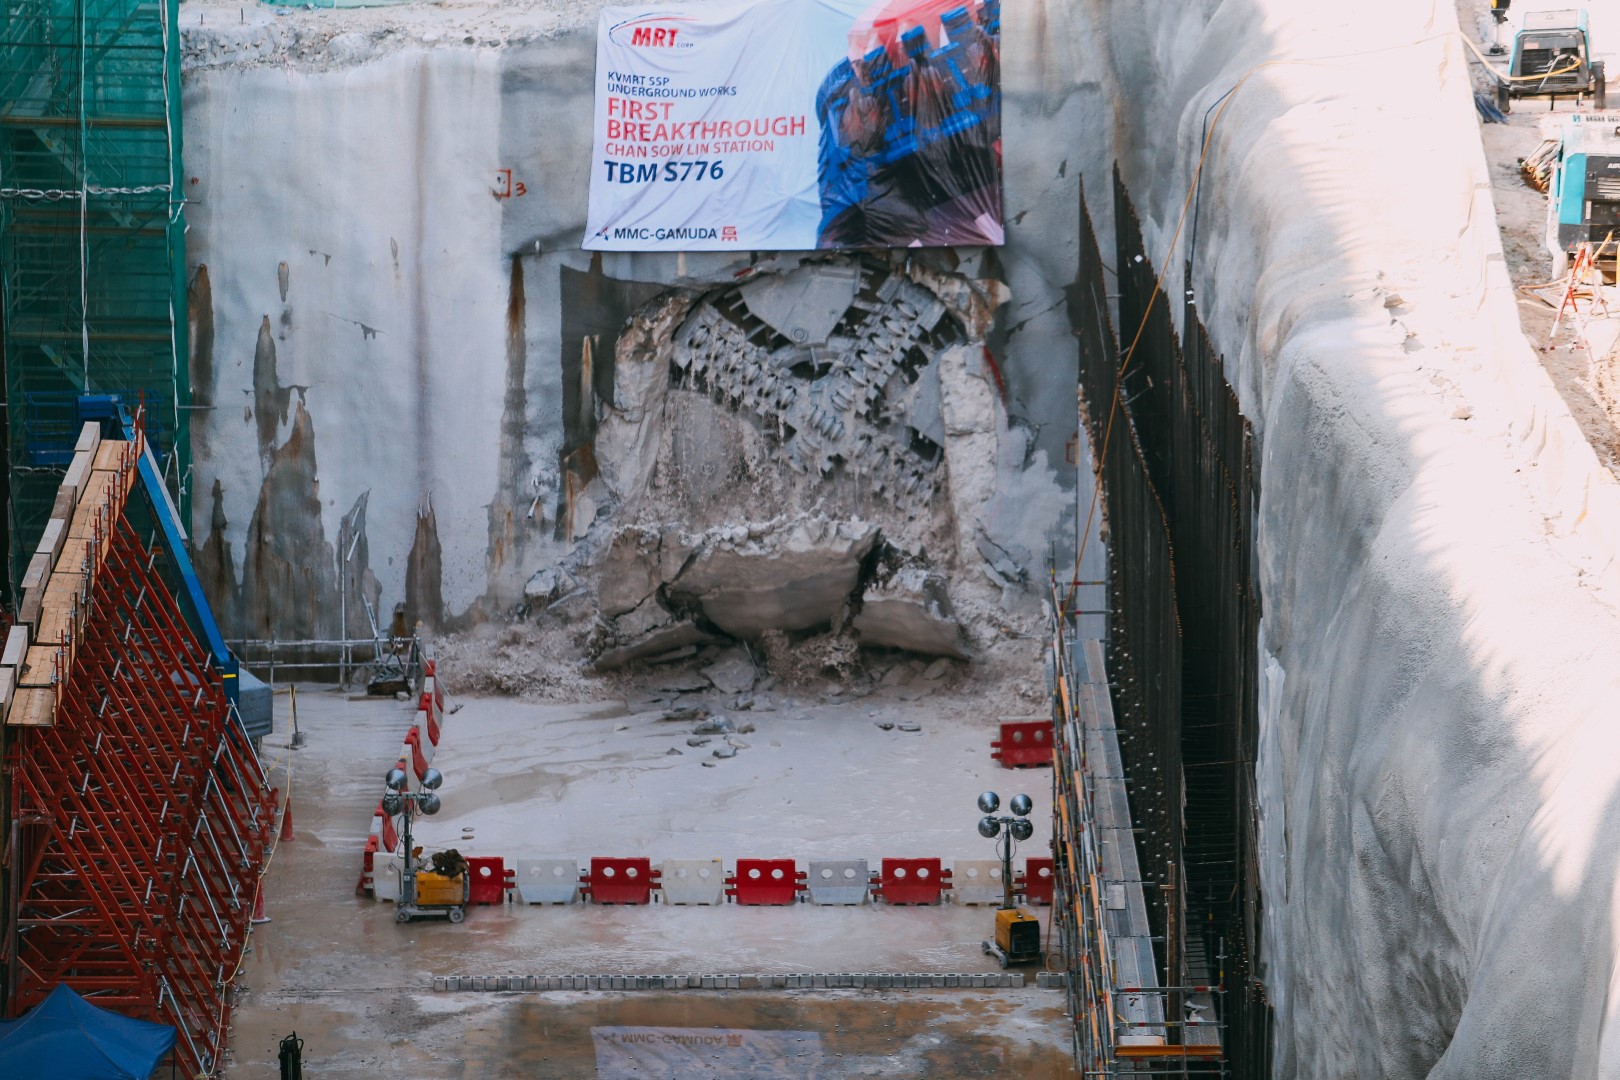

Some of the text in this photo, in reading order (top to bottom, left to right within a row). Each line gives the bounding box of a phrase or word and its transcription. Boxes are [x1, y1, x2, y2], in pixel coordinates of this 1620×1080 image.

[630, 27, 679, 48] MRT
[607, 71, 670, 87] KVMRT SSP
[607, 82, 737, 98] UNDERGROUND WORKS
[607, 97, 674, 121] FIRST
[606, 115, 806, 143] BREAKTHROUGH
[605, 139, 775, 158] CHAN SOW LIN STATION
[603, 160, 724, 184] TBM S776
[515, 182, 528, 197] 3
[613, 227, 718, 241] MMC-GAMUDA
